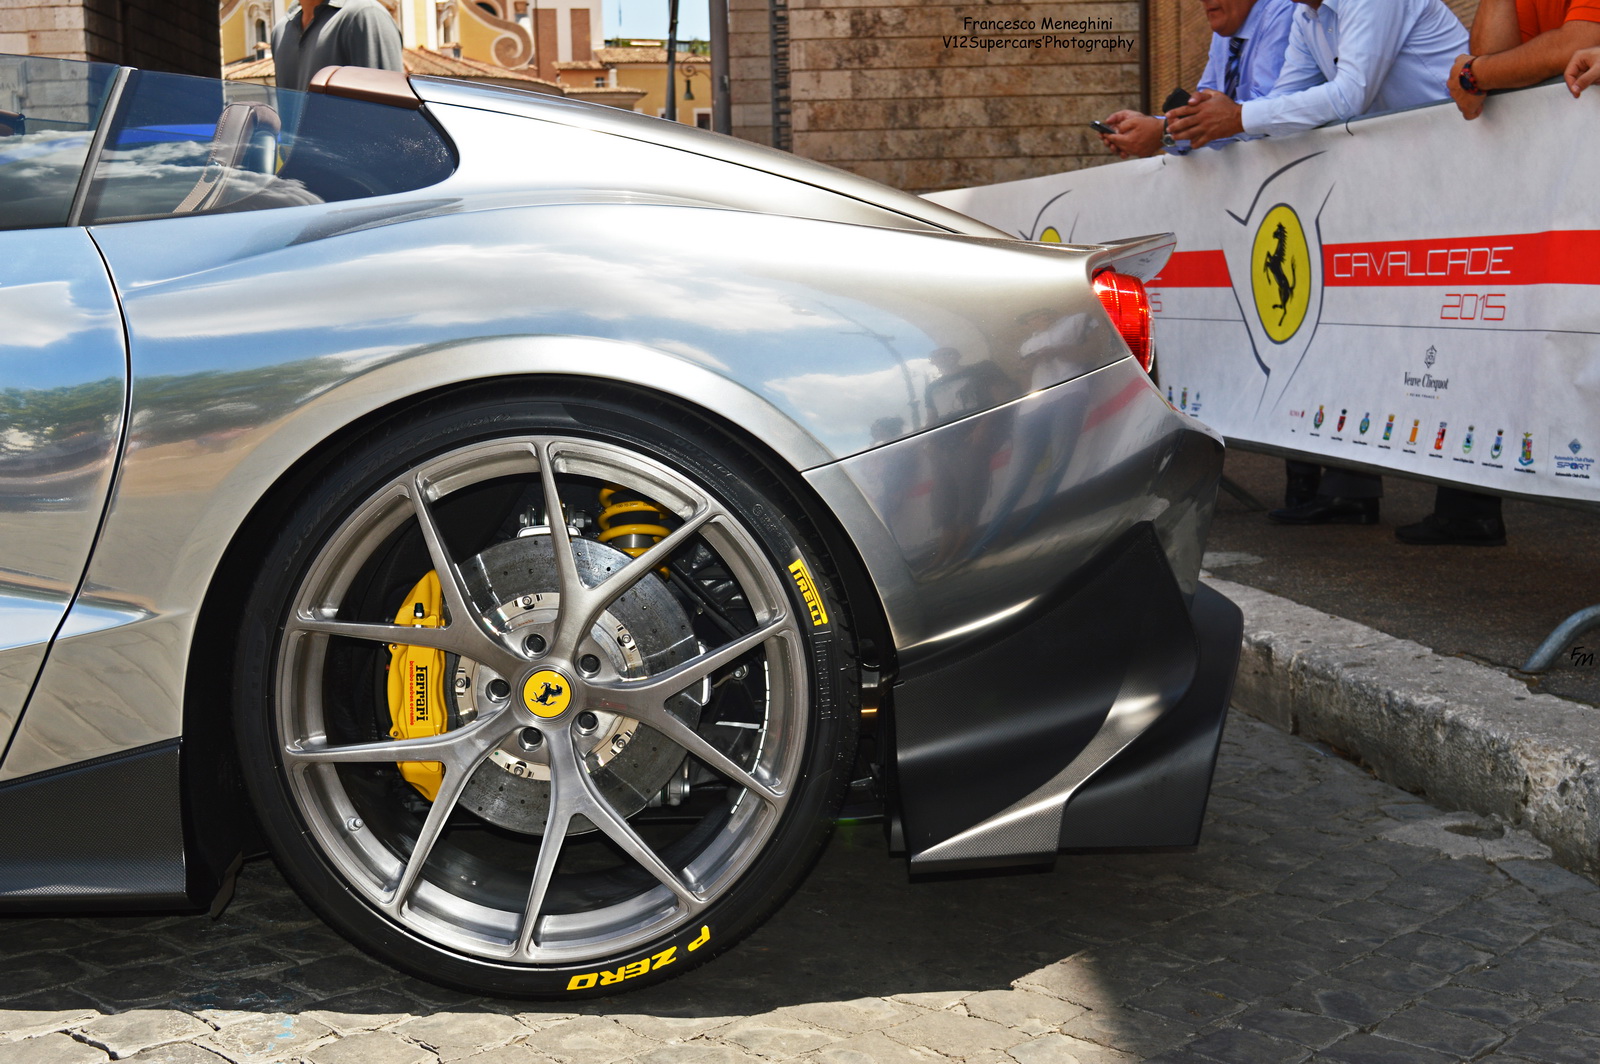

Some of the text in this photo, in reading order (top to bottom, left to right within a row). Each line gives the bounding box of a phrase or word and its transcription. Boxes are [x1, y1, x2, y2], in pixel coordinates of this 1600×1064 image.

[1333, 246, 1514, 277] CAVALCADE
[1440, 293, 1506, 321] 2015
[1556, 462, 1591, 470] SPORT
[788, 558, 829, 627] PIRELLI
[416, 665, 428, 721] Ferrari
[566, 925, 711, 991] P ZERO
